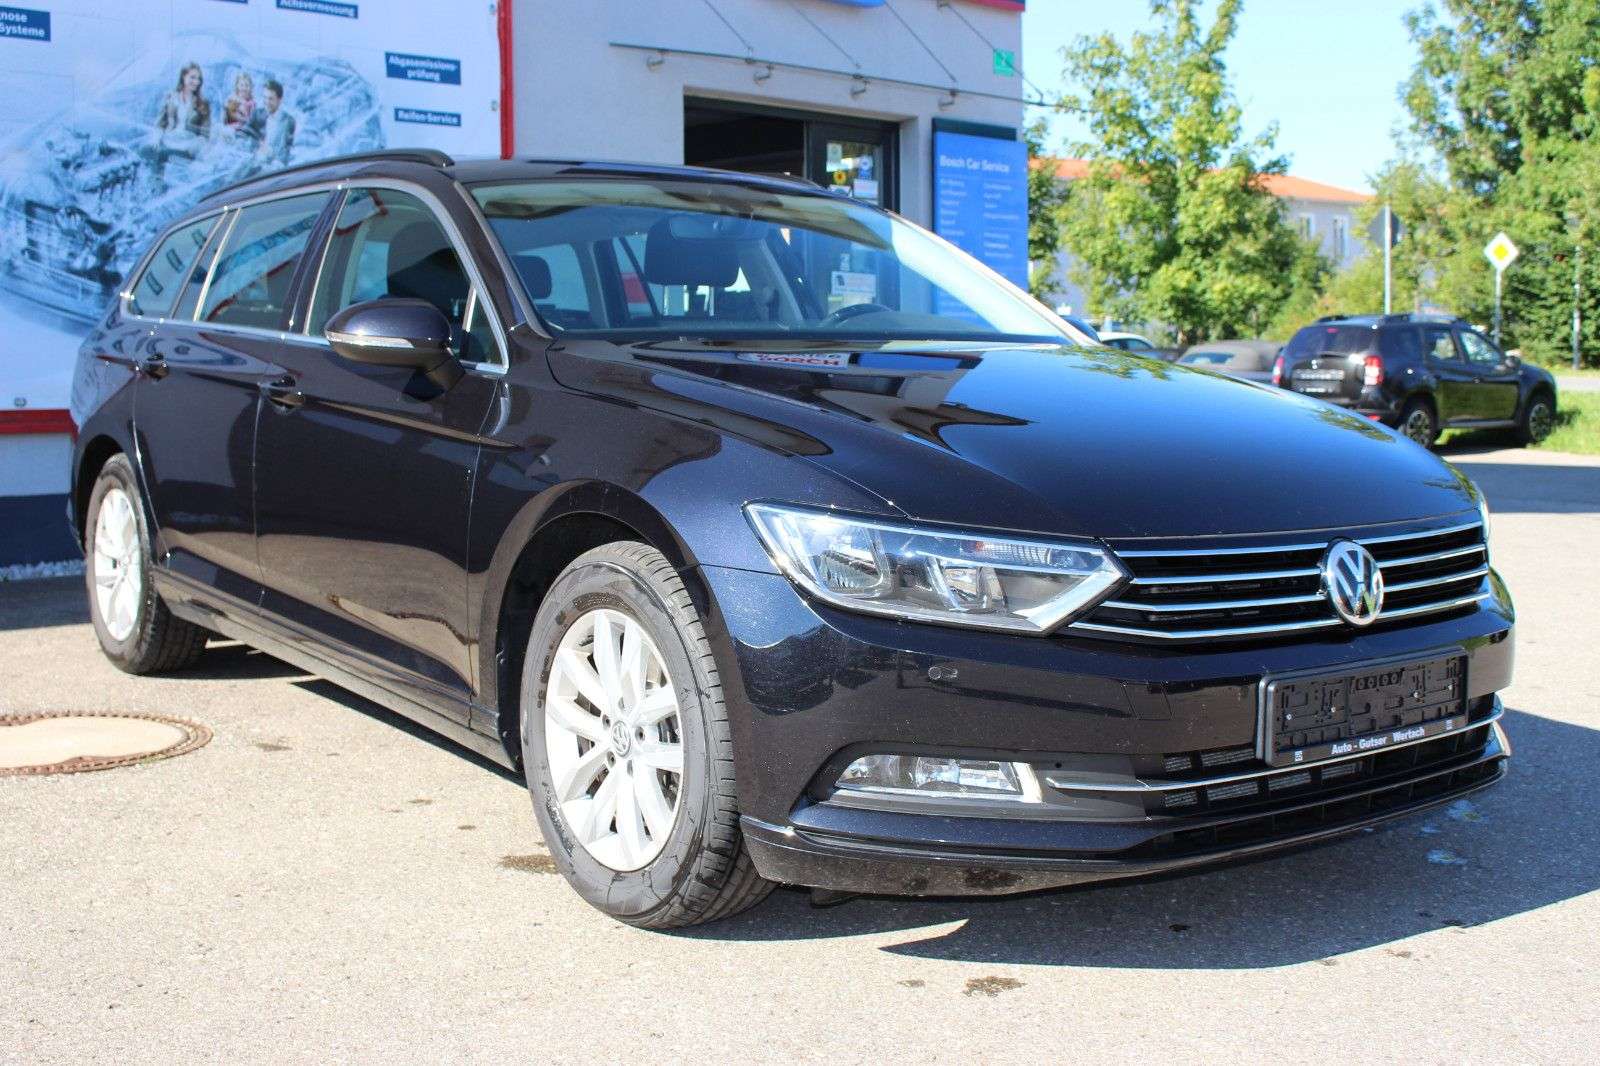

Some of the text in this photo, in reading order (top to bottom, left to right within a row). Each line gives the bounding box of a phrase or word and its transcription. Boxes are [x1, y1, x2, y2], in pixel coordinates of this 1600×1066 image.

[940, 155, 1010, 173] Bosch Car Service
[1331, 743, 1352, 755] Auto
[1392, 727, 1424, 742] Wertach
